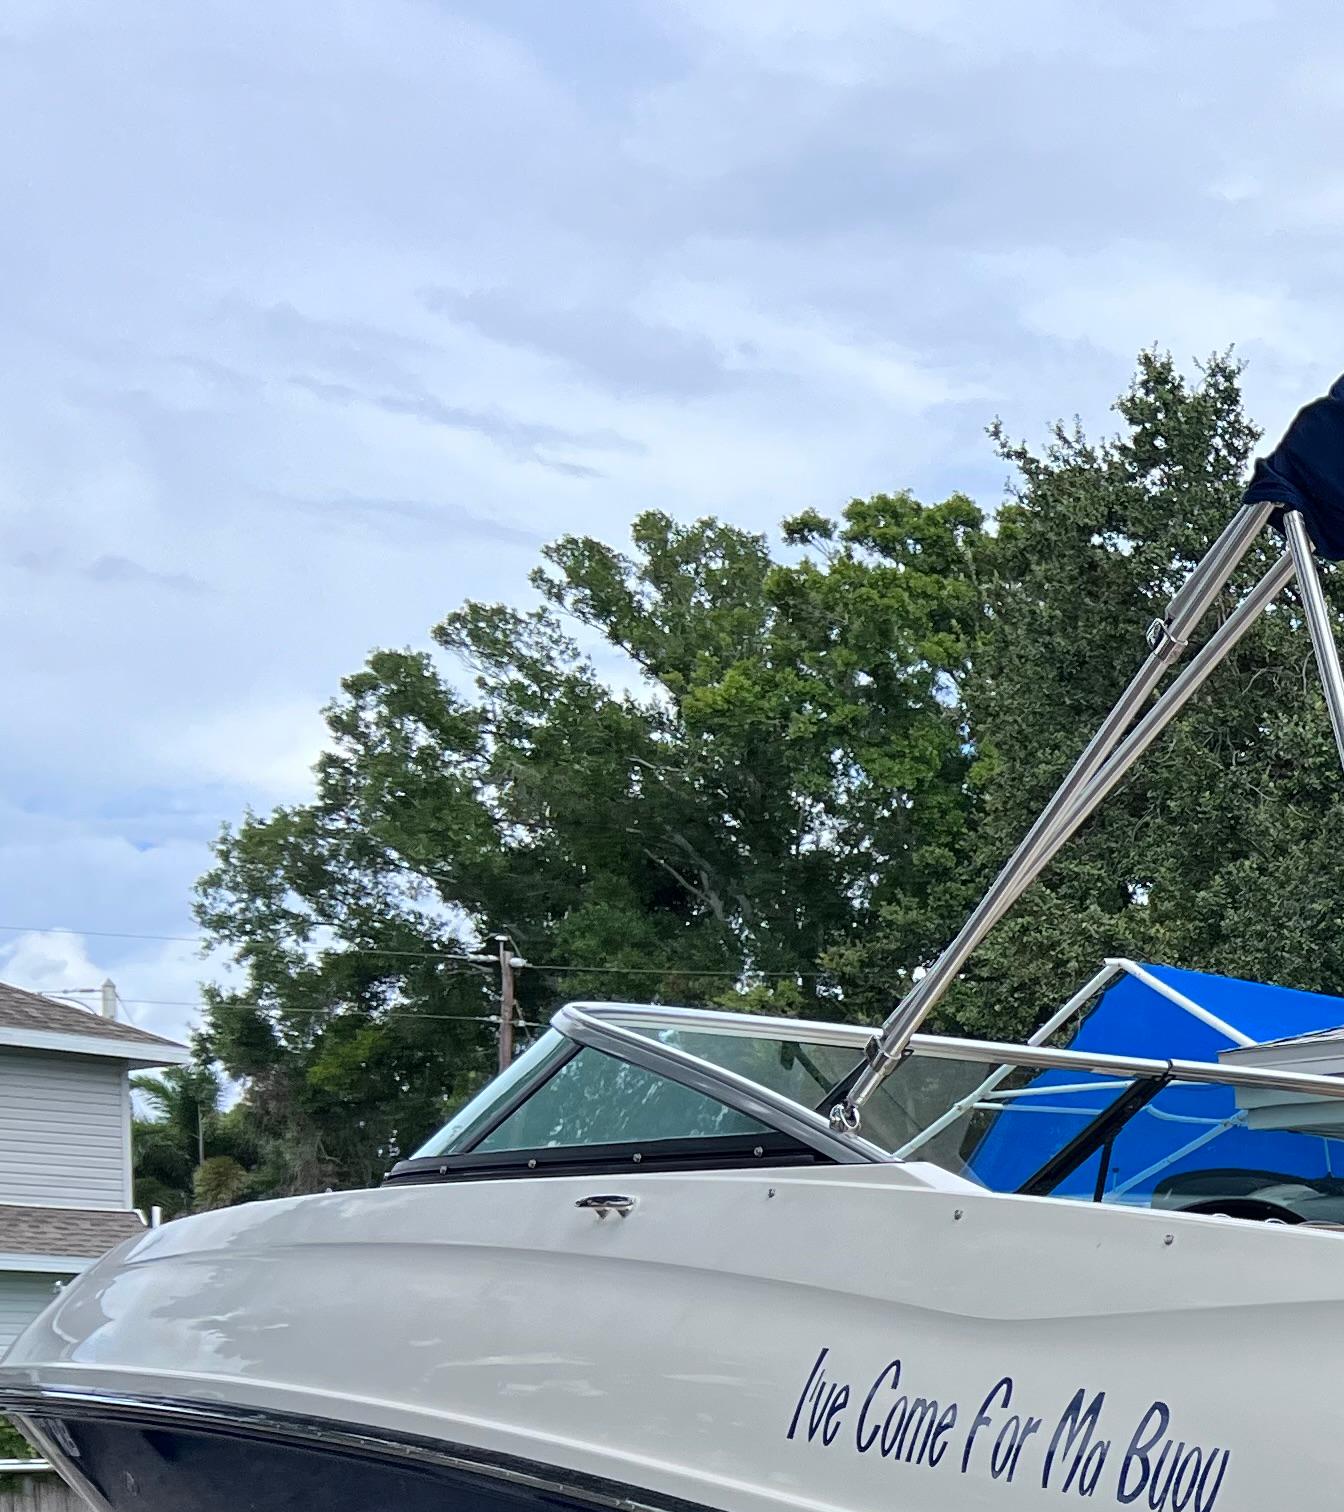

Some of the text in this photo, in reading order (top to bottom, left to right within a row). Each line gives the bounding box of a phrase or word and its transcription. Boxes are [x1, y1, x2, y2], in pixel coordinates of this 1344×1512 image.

[856, 1359, 958, 1468] Come
[960, 1377, 1040, 1483] For
[1040, 1388, 1111, 1497] Ma
